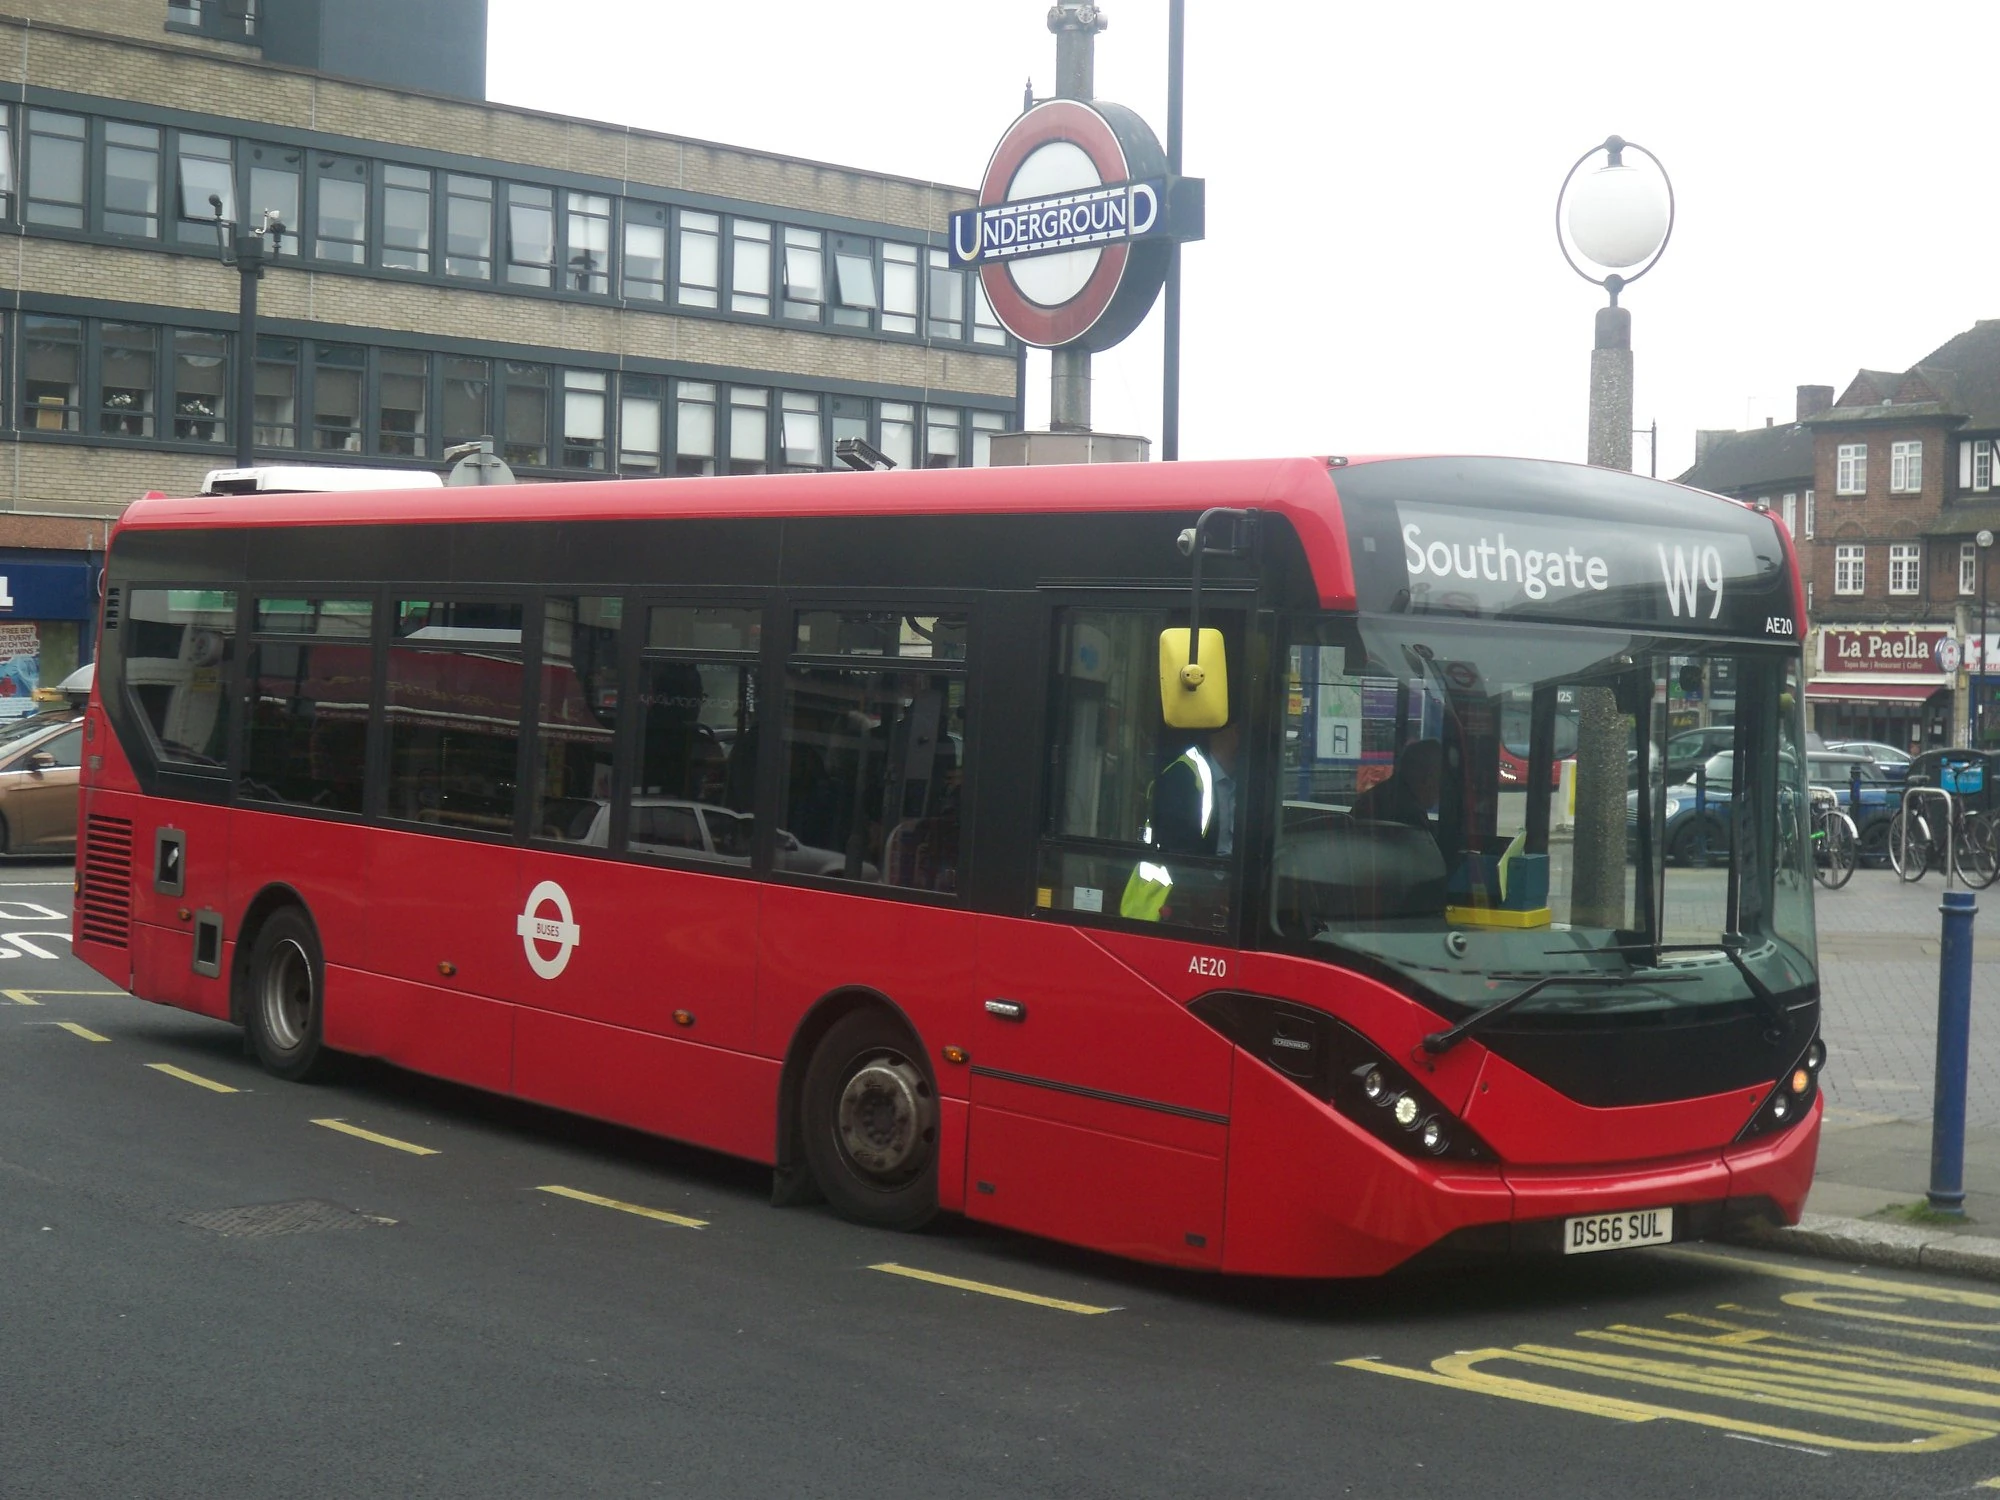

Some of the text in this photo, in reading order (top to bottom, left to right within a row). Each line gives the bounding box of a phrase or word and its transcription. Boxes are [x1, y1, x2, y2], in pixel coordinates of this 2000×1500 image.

[955, 183, 1158, 261] UNDERGROUND
[1402, 523, 1725, 620] Southgate W9
[1765, 616, 1793, 635] AE20
[1838, 635, 1862, 658] La
[1868, 635, 1930, 659] Paella
[1557, 691, 1572, 703] 125
[536, 922, 560, 938] BUSES
[1188, 955, 1227, 978] AE20
[1573, 1212, 1663, 1248] DS66 SUL
